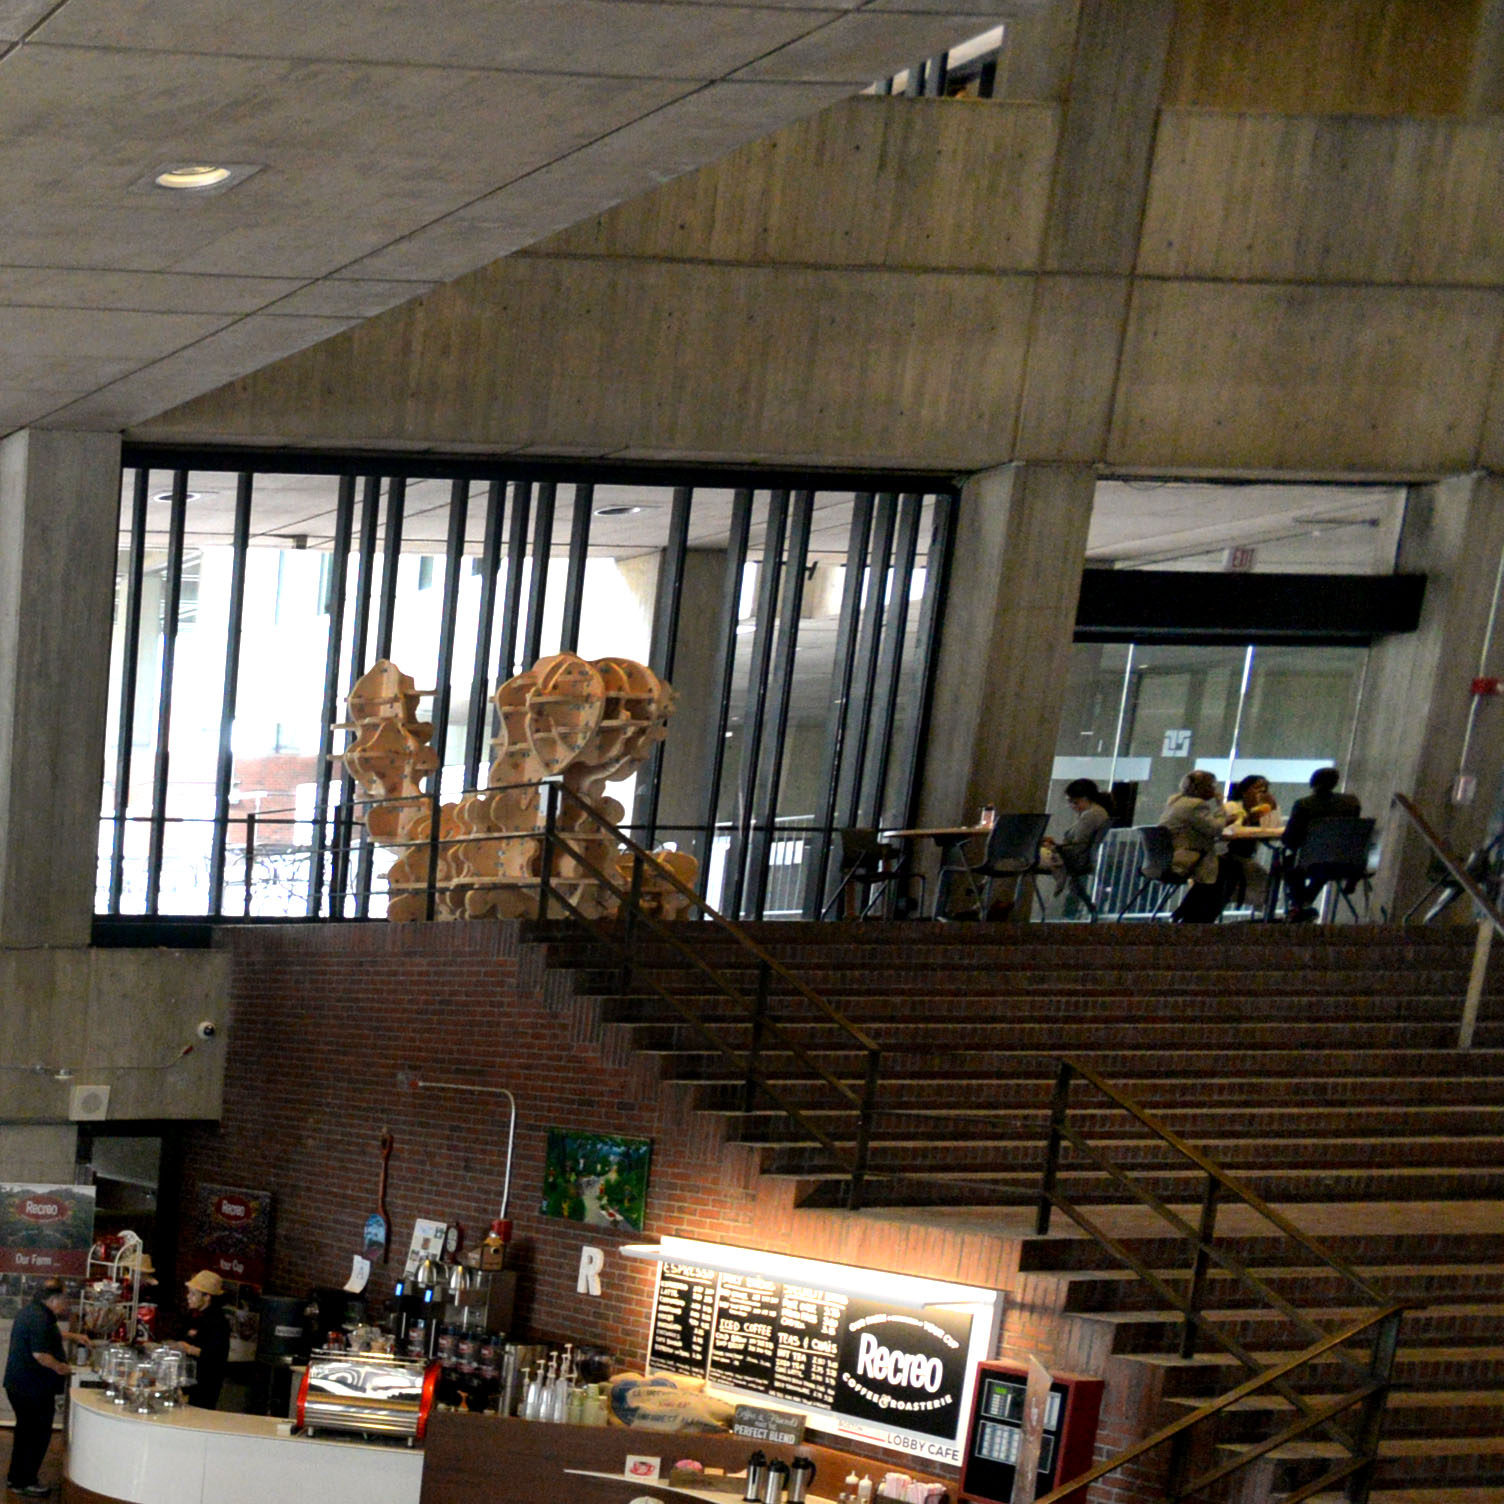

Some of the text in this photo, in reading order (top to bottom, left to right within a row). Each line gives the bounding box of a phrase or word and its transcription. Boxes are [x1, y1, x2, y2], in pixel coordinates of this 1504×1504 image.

[26, 1201, 58, 1216] Recreo
[221, 1202, 246, 1217] Recreo
[15, 1253, 52, 1266] Our Farm
[577, 1246, 604, 1296] R
[719, 1319, 772, 1337] ICED COFFEE
[857, 1332, 944, 1393] Recreo
[842, 1372, 880, 1404] COFFEE
[889, 1394, 953, 1411] ROASTERIE
[734, 1424, 769, 1440] PERFECT
[769, 1431, 796, 1445] BLEND
[887, 1433, 960, 1461] LOBBY CAFE
